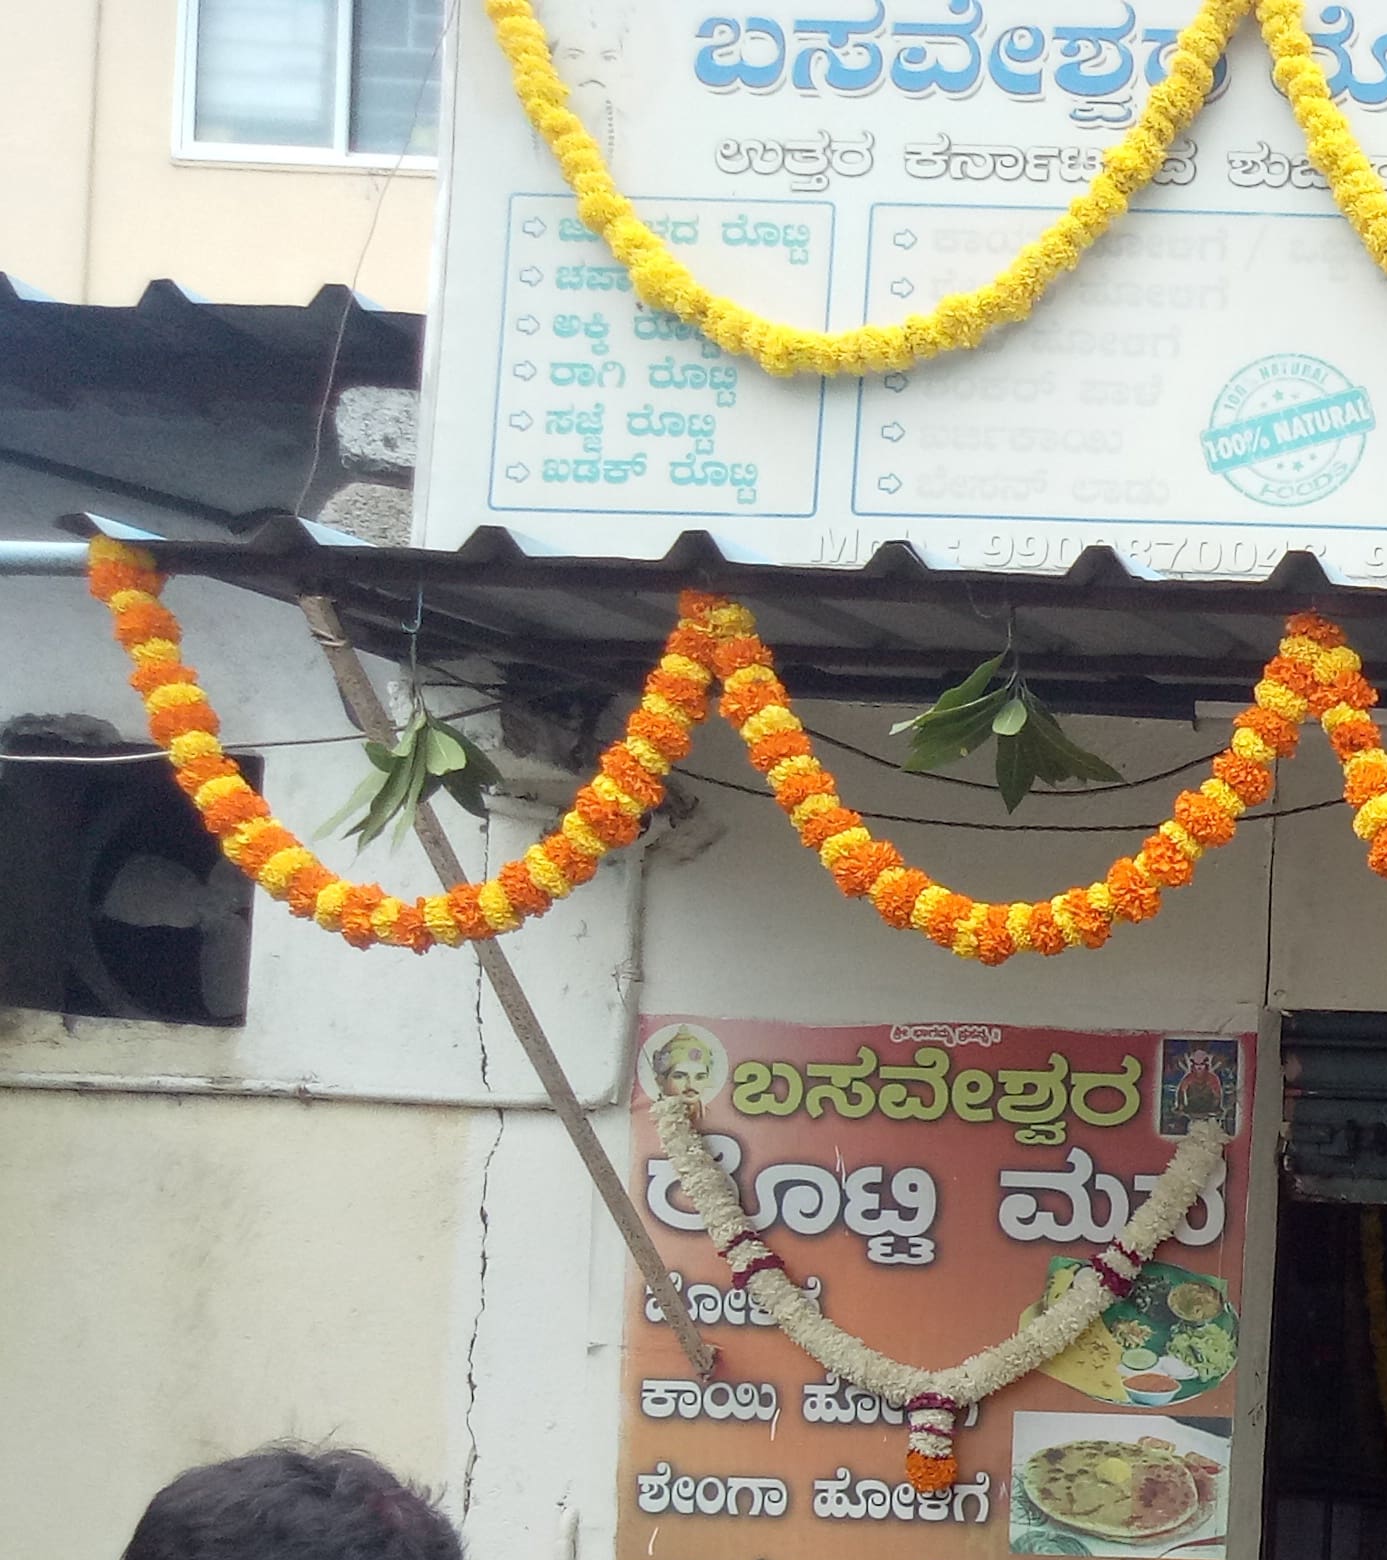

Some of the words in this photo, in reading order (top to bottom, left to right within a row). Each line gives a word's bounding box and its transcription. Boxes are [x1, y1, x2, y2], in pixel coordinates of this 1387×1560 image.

[715, 129, 875, 192] ಉತ್ತರ
[904, 131, 1198, 188] ಕರ್ನಾಟದ
[721, 213, 811, 266] ರೊಟ್ಟಿ
[549, 359, 627, 389] ರಾಗಿ
[648, 355, 738, 408] ರೊಟ್ಟಿ
[626, 403, 716, 456] ರೊಟ್ಟಿ
[1204, 427, 1271, 462] 100%
[1272, 398, 1371, 445] NATURAL
[668, 452, 759, 505] ರೊಟ್ಟಿ
[732, 1045, 1143, 1145] ಬಸವೇಶ್ವರ
[641, 1378, 778, 1421] ಕಾಯಿ
[637, 1461, 788, 1517] ಶೇಂಗಾ
